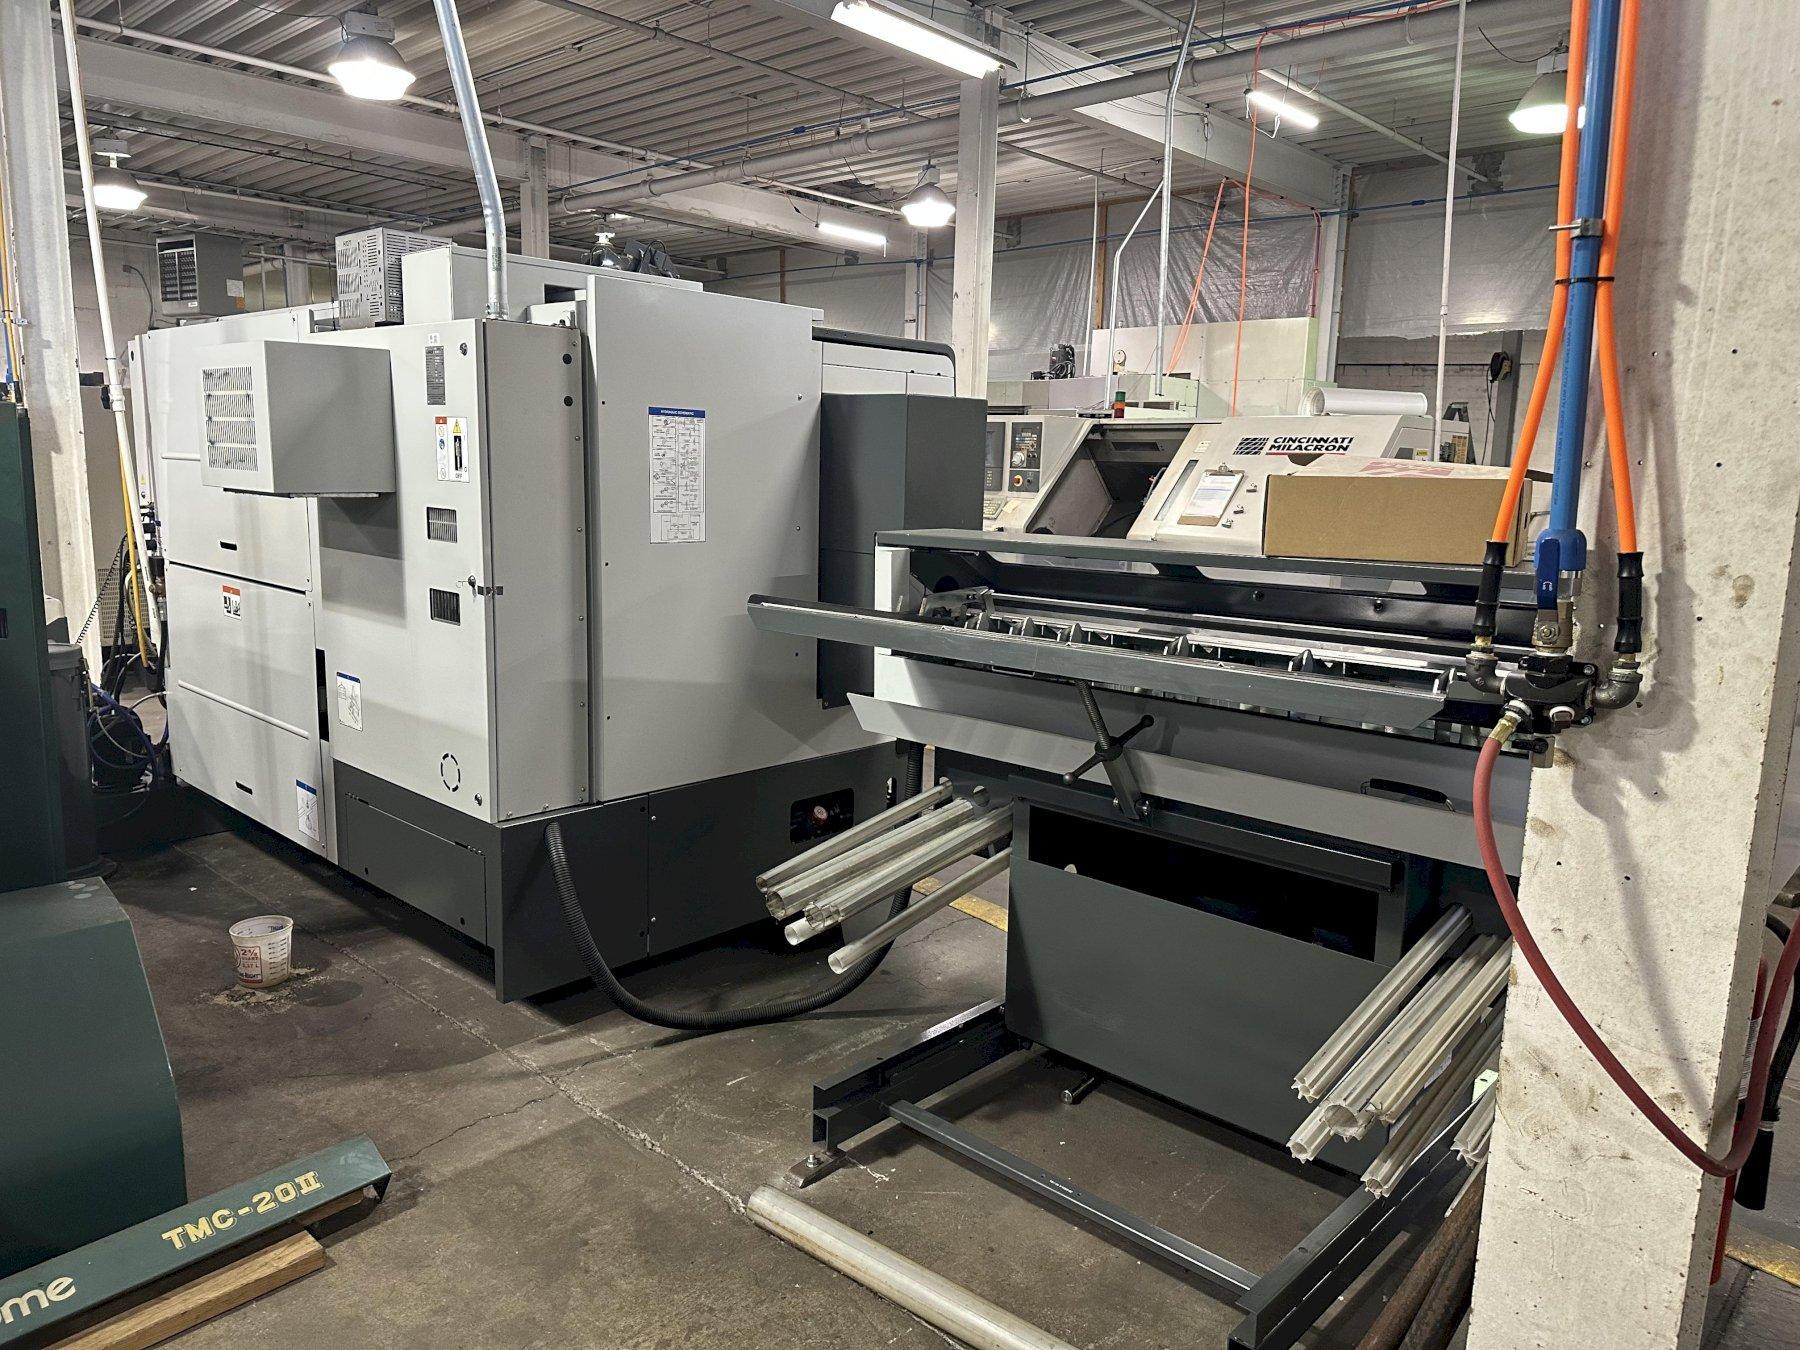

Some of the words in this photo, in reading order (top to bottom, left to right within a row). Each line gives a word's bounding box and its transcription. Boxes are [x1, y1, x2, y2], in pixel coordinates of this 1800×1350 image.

[1273, 436, 1354, 444] CINCINNATI
[1268, 444, 1350, 452] MILACRON
[0, 1276, 77, 1325] me
